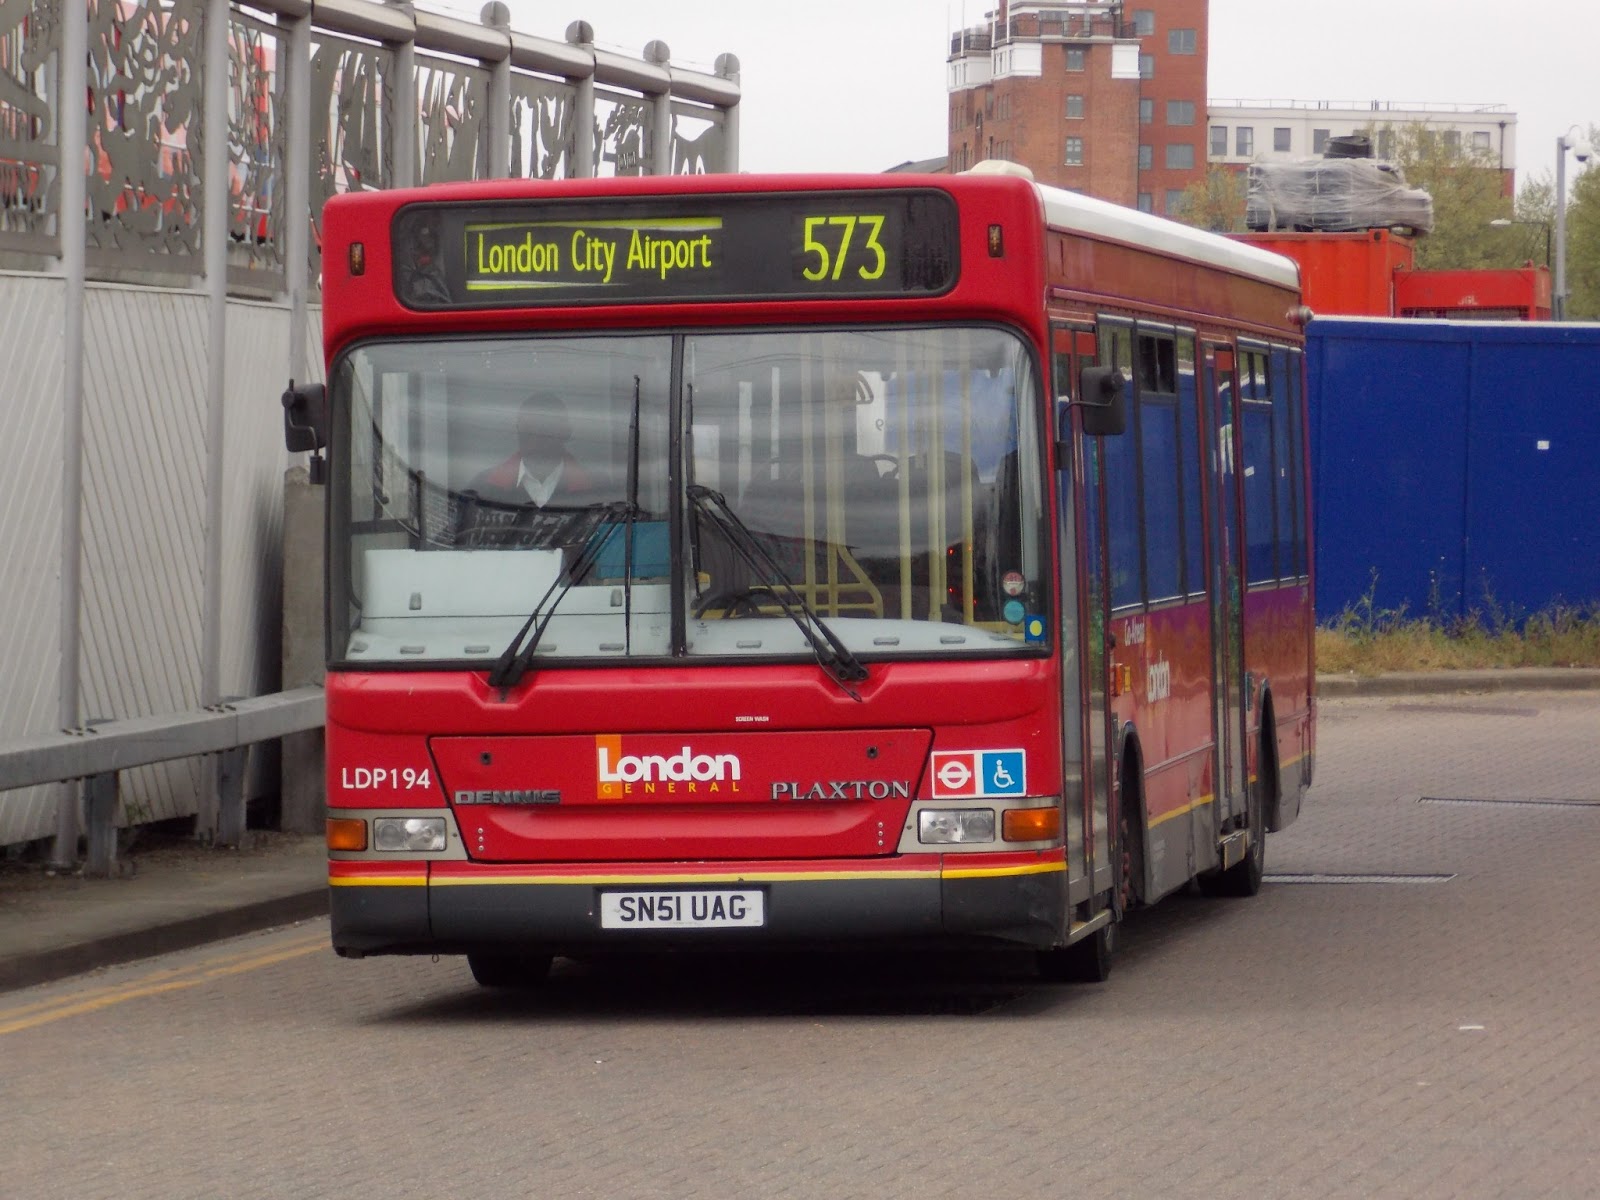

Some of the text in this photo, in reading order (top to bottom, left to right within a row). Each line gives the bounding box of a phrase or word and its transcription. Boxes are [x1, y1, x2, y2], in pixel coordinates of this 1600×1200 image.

[478, 228, 712, 284] London City Airport
[802, 214, 887, 282] 573
[598, 746, 741, 782] London
[342, 767, 431, 790] LDP194
[602, 782, 740, 794] GENERAL
[771, 780, 910, 800] PLAXTON
[454, 790, 562, 805] DENNIS
[619, 895, 747, 922] SN51 UAG
